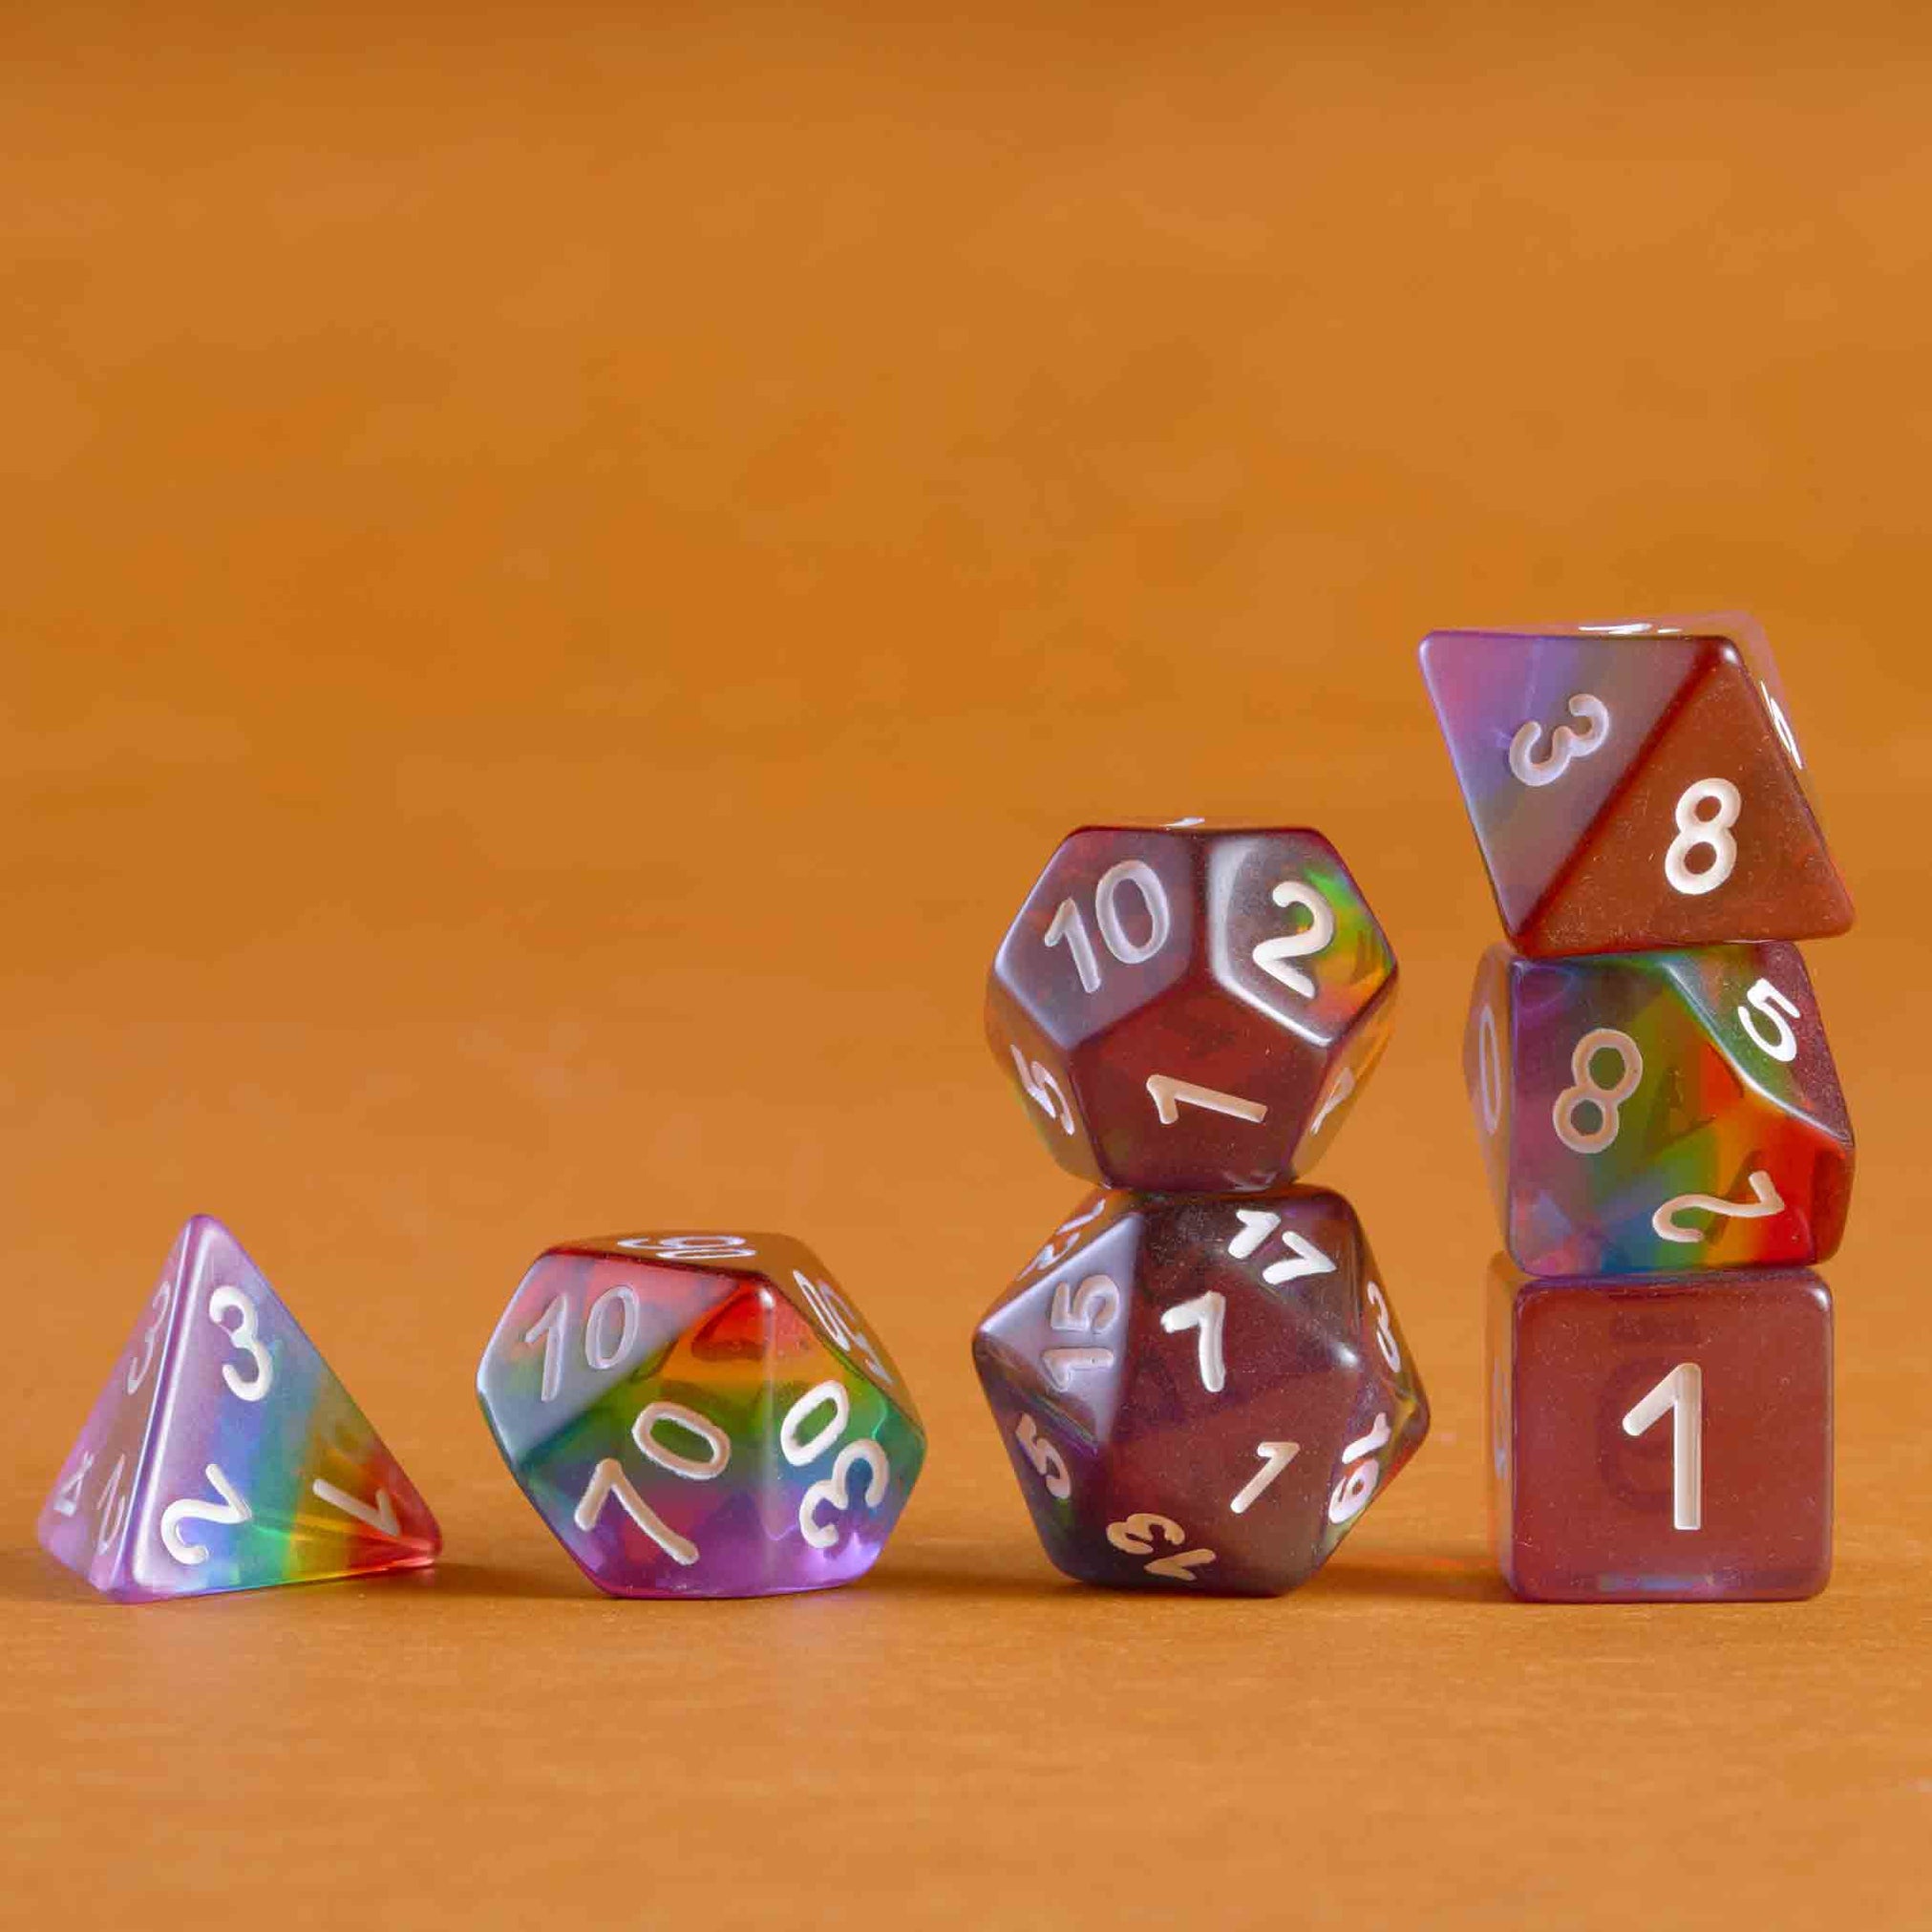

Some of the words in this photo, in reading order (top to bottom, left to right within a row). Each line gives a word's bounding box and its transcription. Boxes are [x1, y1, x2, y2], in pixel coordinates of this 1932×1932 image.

[1509, 692, 1610, 787] 3
[1665, 776, 1742, 895] 8
[1045, 860, 1171, 994] 10
[1252, 881, 1335, 999] 2
[1737, 978, 1800, 1062] 5
[1146, 1074, 1268, 1125] 1
[1553, 1028, 1643, 1154] 8
[1228, 1209, 1336, 1285] 17
[1652, 1170, 1785, 1242] 2
[209, 1285, 274, 1401] 3
[525, 1284, 640, 1402] 10
[1041, 1274, 1120, 1392] 15
[1160, 1291, 1225, 1392] 7
[574, 1401, 732, 1566] 70
[780, 1380, 889, 1549] 30
[1015, 1413, 1072, 1499] 5
[1230, 1441, 1300, 1514] 1
[1623, 1362, 1702, 1531] 1
[160, 1464, 252, 1565] 2
[312, 1478, 400, 1538] 1
